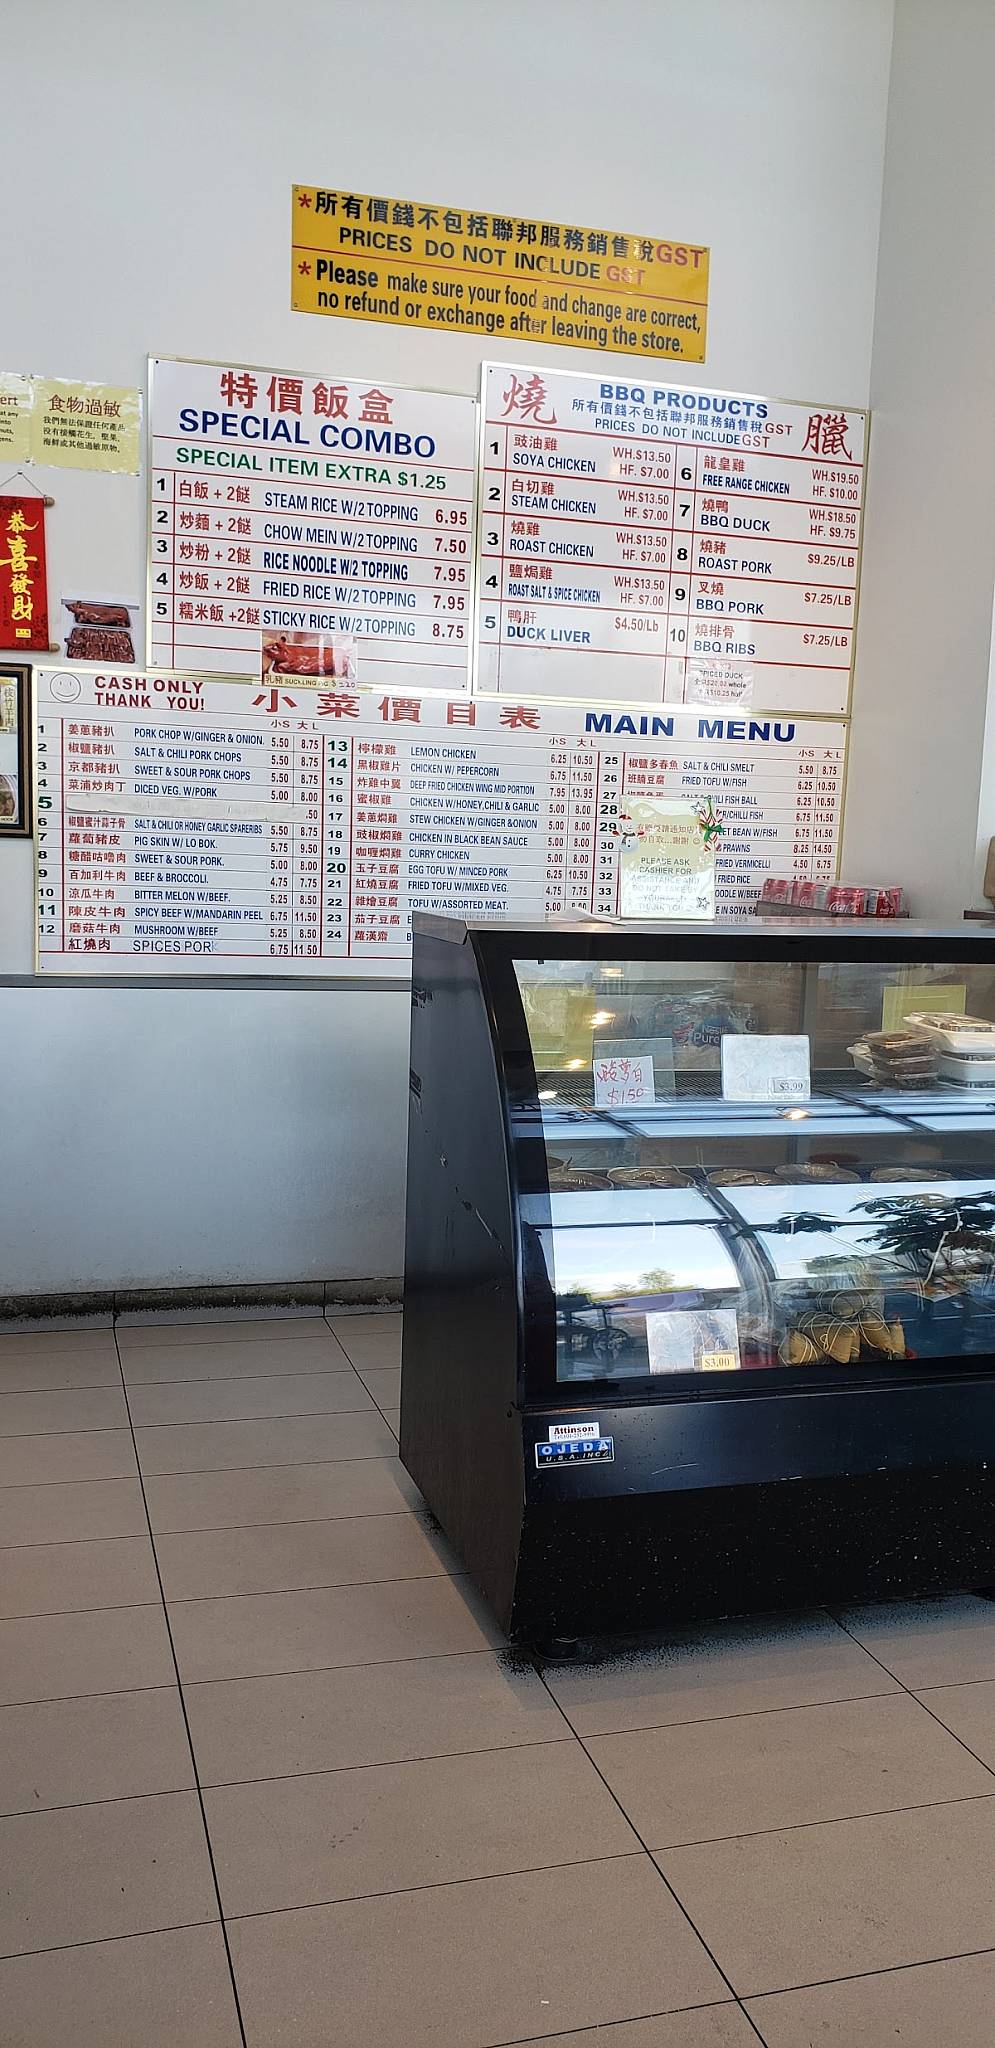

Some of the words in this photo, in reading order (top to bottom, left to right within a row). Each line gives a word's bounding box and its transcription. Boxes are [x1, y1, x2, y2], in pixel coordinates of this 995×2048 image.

[339, 227, 412, 253] PRICES
[425, 240, 455, 258] DO
[463, 245, 507, 266] NOT
[515, 252, 601, 280] INCLUDE
[606, 266, 646, 284] GST
[316, 259, 379, 287] Please
[388, 275, 427, 294] make
[433, 280, 464, 298] sure
[468, 286, 501, 305] your
[505, 286, 537, 307] food
[543, 292, 568, 312] and
[572, 297, 621, 321] change
[626, 305, 646, 322] are
[651, 308, 701, 332] correct,
[318, 292, 338, 309] no
[344, 292, 400, 316] refund
[405, 301, 422, 319] or
[428, 304, 504, 331] exchange
[510, 312, 547, 333] after
[552, 316, 608, 346] leaving
[613, 325, 637, 345] the
[642, 329, 683, 352] store.
[49, 394, 121, 417] 食物過敏
[221, 371, 393, 425] 特價飯盒
[600, 384, 645, 403] BBQ
[654, 391, 768, 419] PRODUCTS
[179, 408, 310, 445] SPECIAL
[320, 424, 435, 458] COMBO
[595, 418, 635, 433] PRICES
[642, 425, 658, 436] DO
[663, 426, 688, 439] NOT
[490, 442, 500, 455] 1
[513, 453, 544, 466] SOYA
[547, 456, 596, 473] CHICKEN
[612, 447, 671, 463] WH.$13.50
[176, 447, 262, 471] SPECIAL
[270, 458, 318, 476] ITEM
[326, 464, 391, 485] EXTRA
[398, 471, 446, 490] $1.25
[619, 464, 636, 477] HF.
[640, 465, 669, 479] $7.00
[680, 467, 692, 480] 6
[704, 455, 745, 473] 龍皇雞
[703, 473, 723, 486] FREE
[726, 476, 752, 491] RANGE
[755, 479, 790, 495] CHICKEN
[812, 470, 859, 486] WH.$19.50
[812, 486, 830, 497] HF.
[833, 487, 858, 500] $10.00
[157, 478, 166, 491] 1
[179, 480, 209, 500] 白飯
[214, 490, 222, 500] +
[265, 492, 308, 510] STEAM
[312, 498, 337, 514] RICE
[366, 503, 418, 521] TOPPING
[436, 509, 467, 525] 6.95
[680, 504, 690, 517] 7
[702, 498, 729, 513] 燒鴨
[701, 515, 729, 529] BBQ
[733, 518, 770, 533] DUCK
[809, 509, 856, 525] WH.$18.50
[810, 525, 826, 537] HF.
[830, 526, 856, 540] $9.75
[677, 548, 688, 561] 8
[700, 540, 725, 555] 燒豬
[0, 509, 39, 621] 恭喜發財
[698, 557, 737, 572] ROAST
[740, 561, 772, 574] PORK
[808, 553, 855, 569] $9.25/LB
[157, 603, 167, 615] 5
[179, 602, 224, 622] 糯米飯
[263, 610, 306, 627] STICKY
[310, 614, 336, 629] RICE
[365, 619, 416, 636] TOPPING
[432, 623, 464, 639] 8.75
[485, 616, 496, 629] 5
[508, 608, 537, 624] 鴨肝
[507, 626, 546, 641] DUCK
[550, 630, 591, 644] LIVER
[615, 617, 659, 633] $4.50/Lb
[95, 676, 147, 691] CASH
[153, 679, 203, 694] ONLY
[95, 692, 151, 707] THANK
[167, 696, 205, 710] YOU!
[251, 689, 541, 730] 小菜價目表
[38, 725, 44, 733] 1
[135, 728, 156, 738] PORK
[159, 730, 181, 740] CHOP
[183, 731, 227, 743] W/GINGER
[228, 734, 234, 743] &
[271, 737, 289, 748] 5.50
[301, 739, 319, 750] 8.75
[585, 713, 674, 736] MAIN
[698, 719, 795, 742] MENU
[328, 741, 348, 752] 13
[358, 743, 396, 755] 檸檬雞
[411, 746, 439, 757] LEMON
[442, 748, 476, 760] CHICKEN
[551, 754, 567, 764] 6.25
[573, 755, 593, 765] 10.50
[604, 756, 618, 764] 25
[629, 759, 678, 770] 椒鹽多春魚
[683, 761, 700, 770] SALT
[704, 761, 709, 770] &
[711, 761, 729, 771] CHILI
[731, 762, 754, 773] SMELT
[799, 765, 813, 775] 5.50
[823, 766, 837, 776] 8.75
[722, 843, 751, 853] PRAWNS
[39, 869, 48, 878] 9
[69, 870, 126, 882] 百加利牛肉
[135, 872, 155, 882] BEEF
[157, 873, 163, 882] &
[270, 878, 288, 887] 4.75
[301, 878, 317, 888] 7.75
[39, 925, 55, 933] 12
[135, 926, 185, 936] MUSHROOM
[186, 926, 218, 937] W/BEEF
[270, 928, 288, 938] 5.25
[299, 929, 317, 939] 8.50
[779, 1082, 803, 1091] $3.99
[705, 1358, 730, 1368] $3.00
[553, 1425, 594, 1435] Attinson
[542, 1440, 609, 1454] OJEDA
